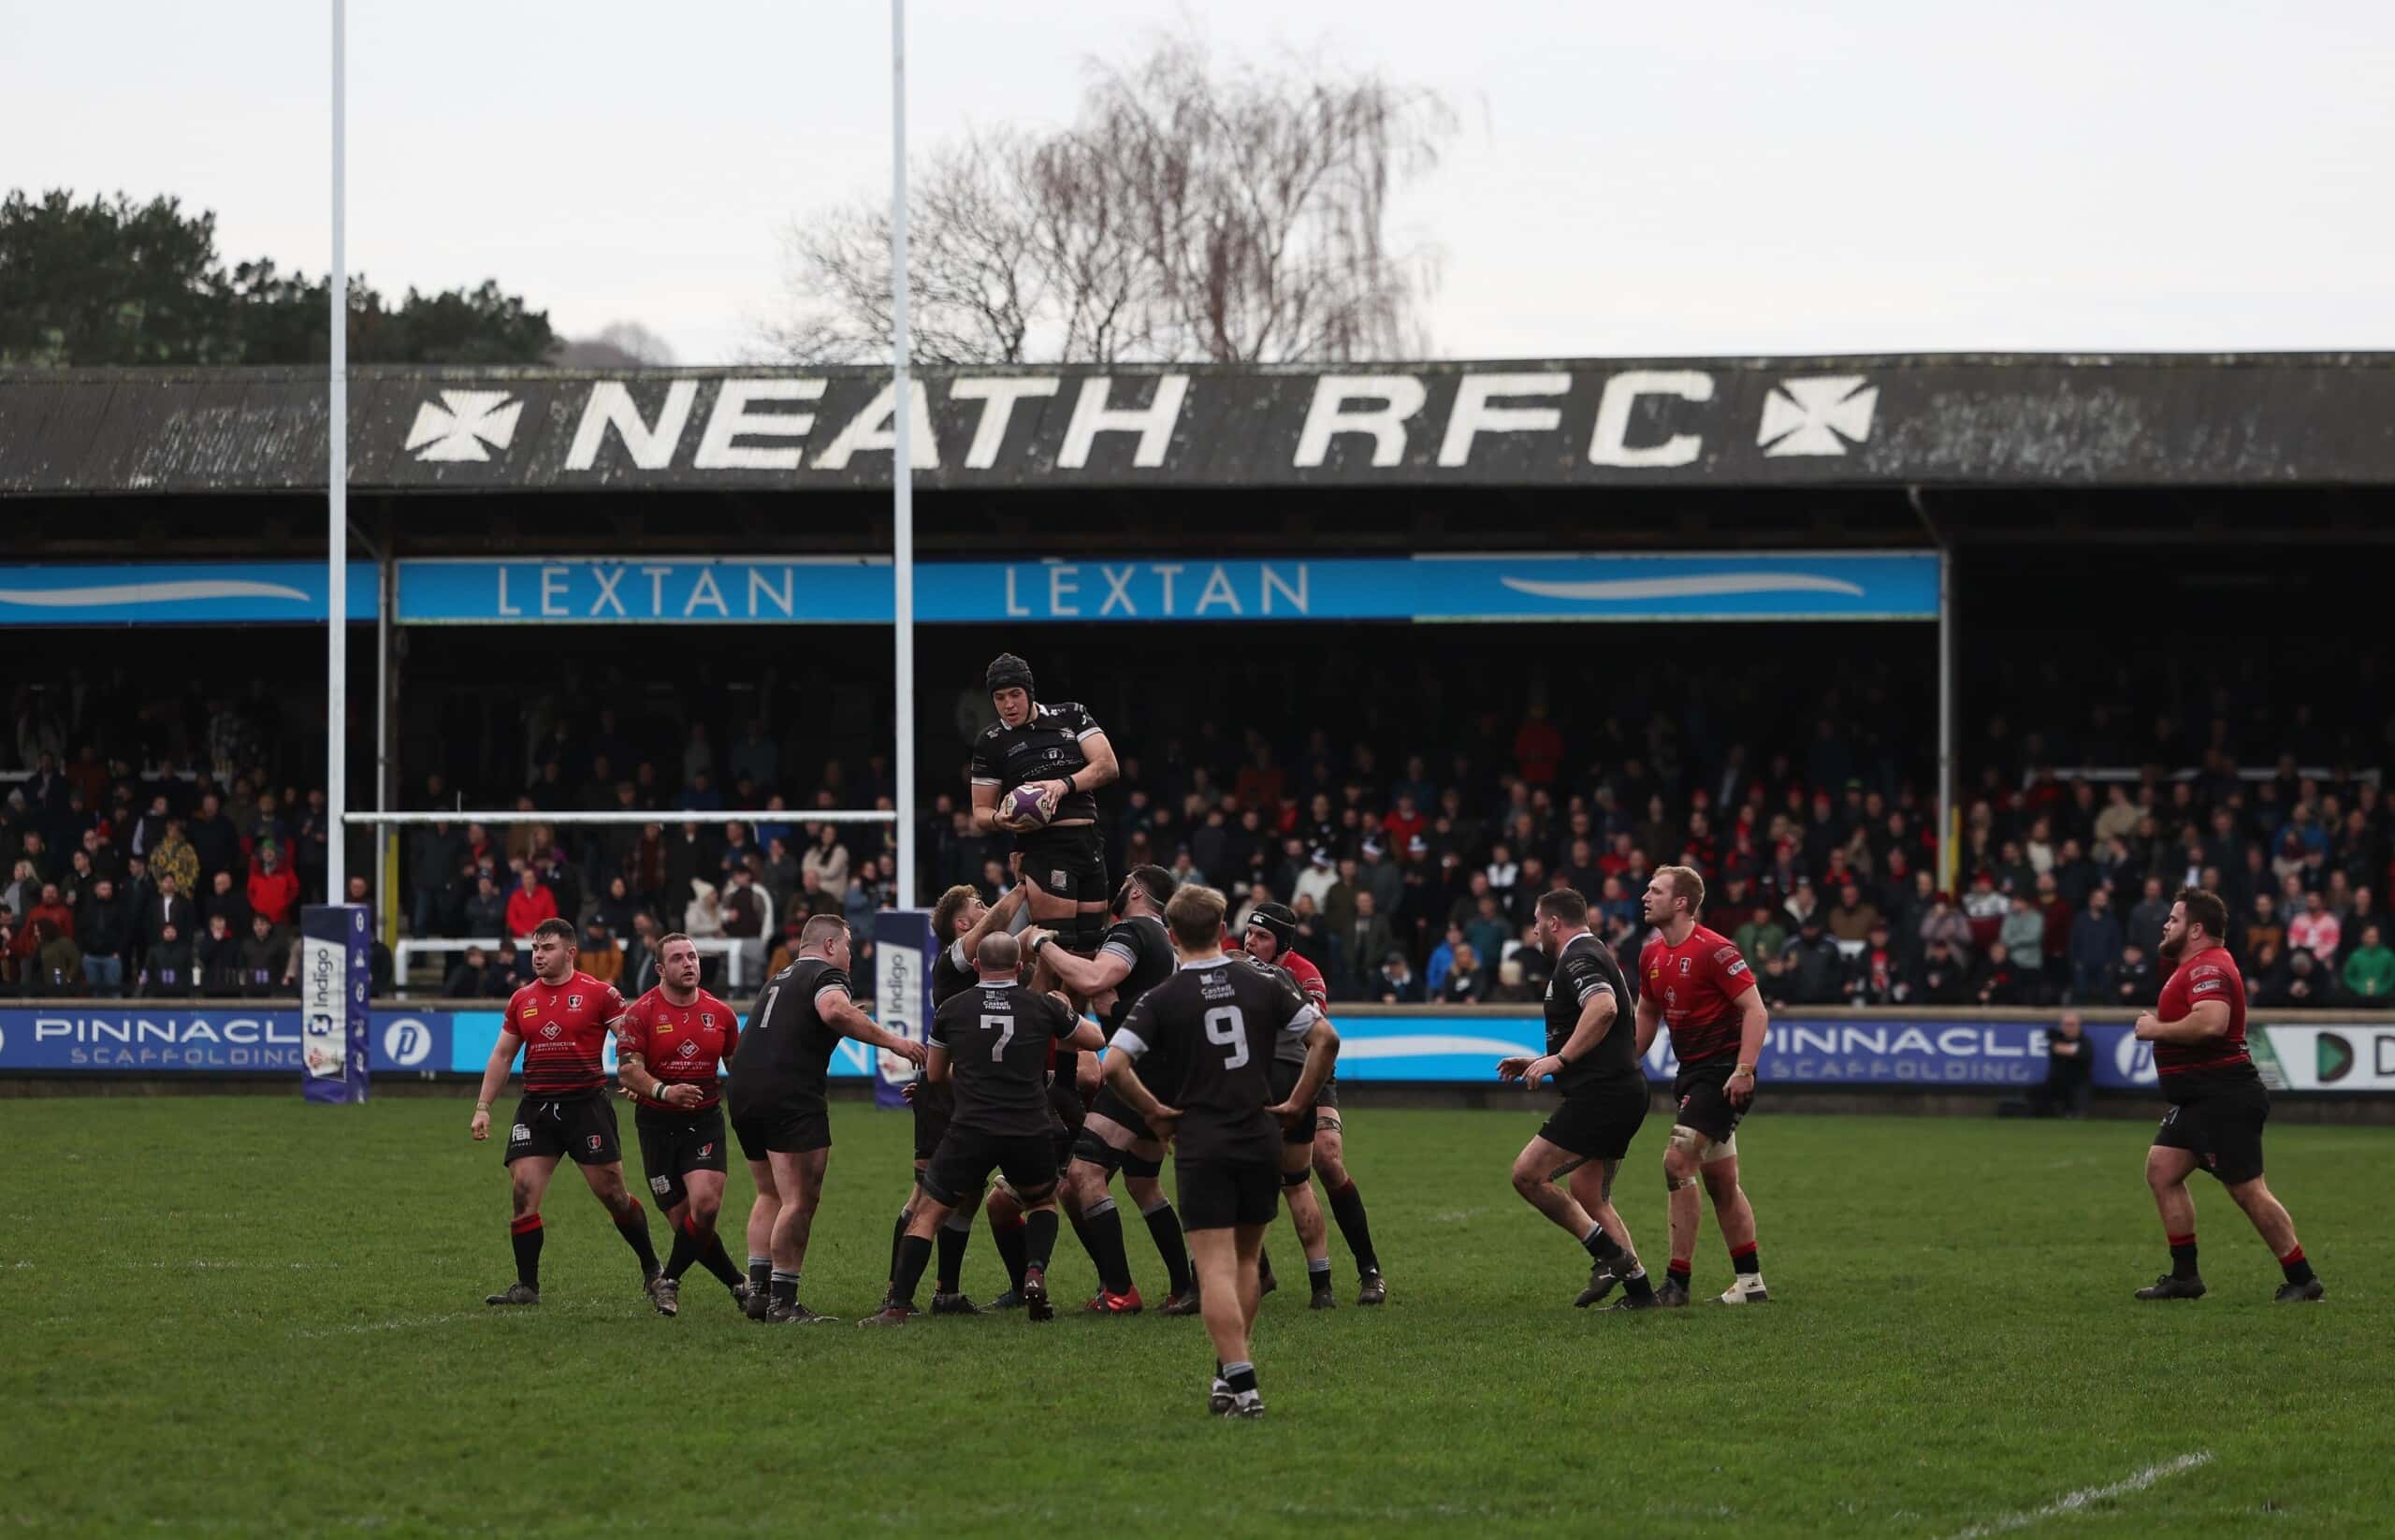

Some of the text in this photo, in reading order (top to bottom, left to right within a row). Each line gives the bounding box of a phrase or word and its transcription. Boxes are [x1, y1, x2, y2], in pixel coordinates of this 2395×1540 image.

[564, 370, 1713, 470] NEATH RFC
[499, 567, 793, 616] LEXTAN
[1006, 566, 1309, 616] LEXTAN
[312, 948, 333, 1007] Indigo
[888, 953, 907, 1014] Indigo
[36, 1019, 301, 1043] PINNACL
[760, 986, 779, 1028] 1
[980, 1014, 1014, 1063] 7
[1204, 1005, 1249, 1070] 9
[1771, 1059, 2031, 1082] SCAFFOLDING
